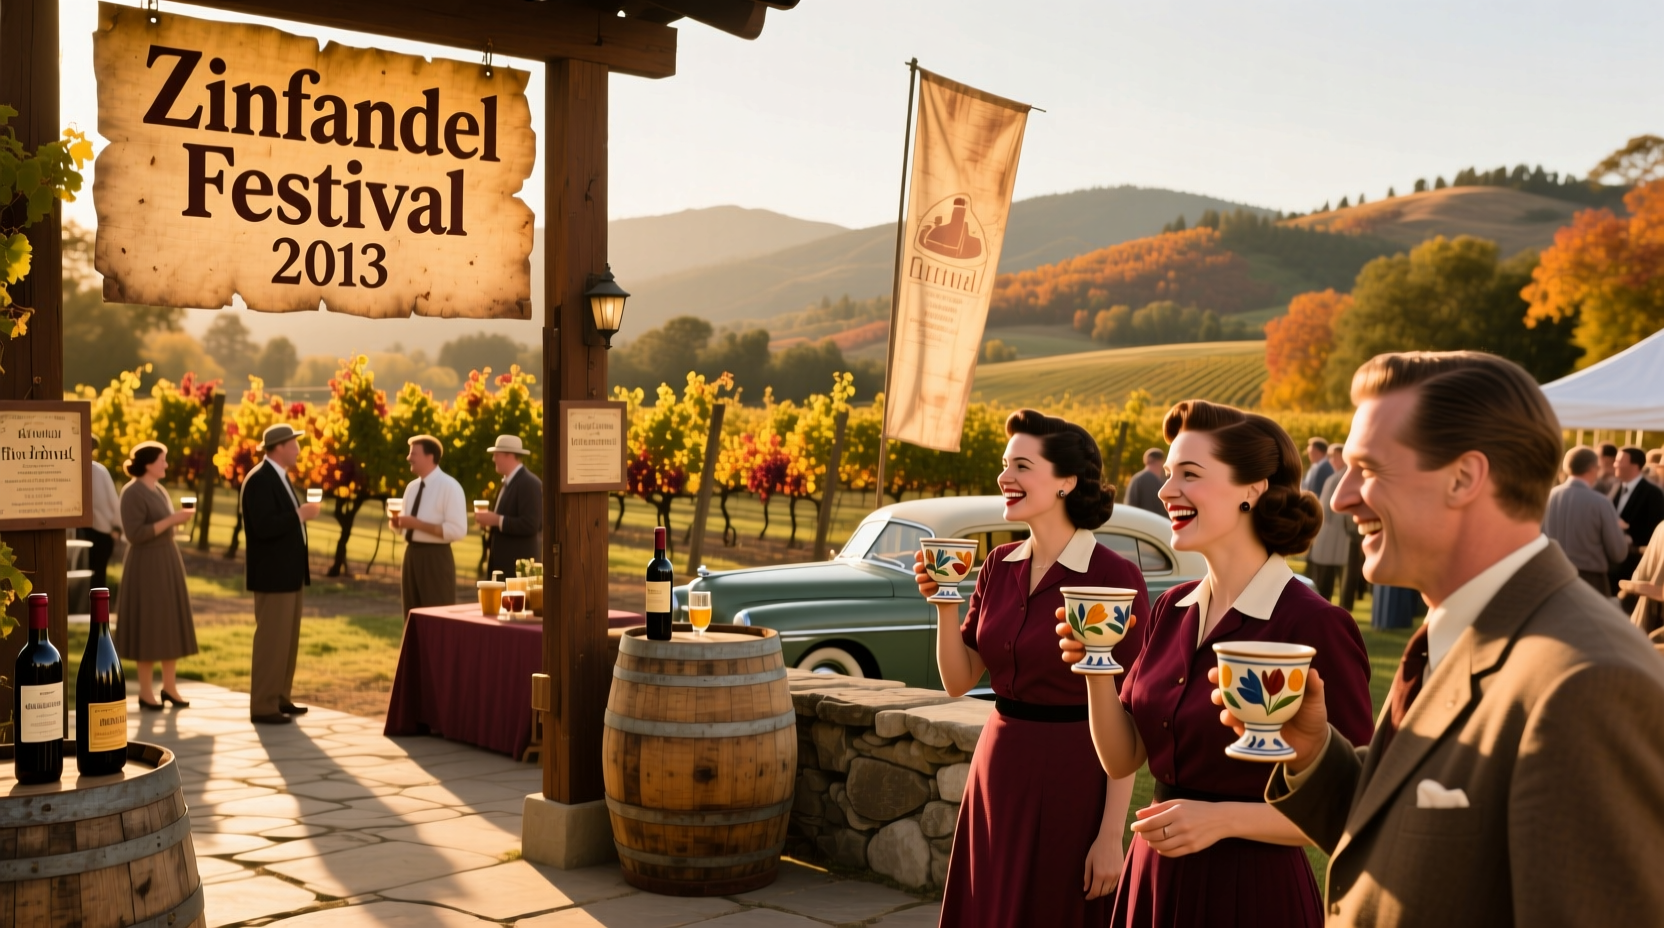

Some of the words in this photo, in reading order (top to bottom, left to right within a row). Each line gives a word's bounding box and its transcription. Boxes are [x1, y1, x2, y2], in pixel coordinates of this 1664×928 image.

[143, 45, 500, 162] Zinfandel
[182, 143, 468, 236] Festival
[272, 238, 388, 289] 2013
